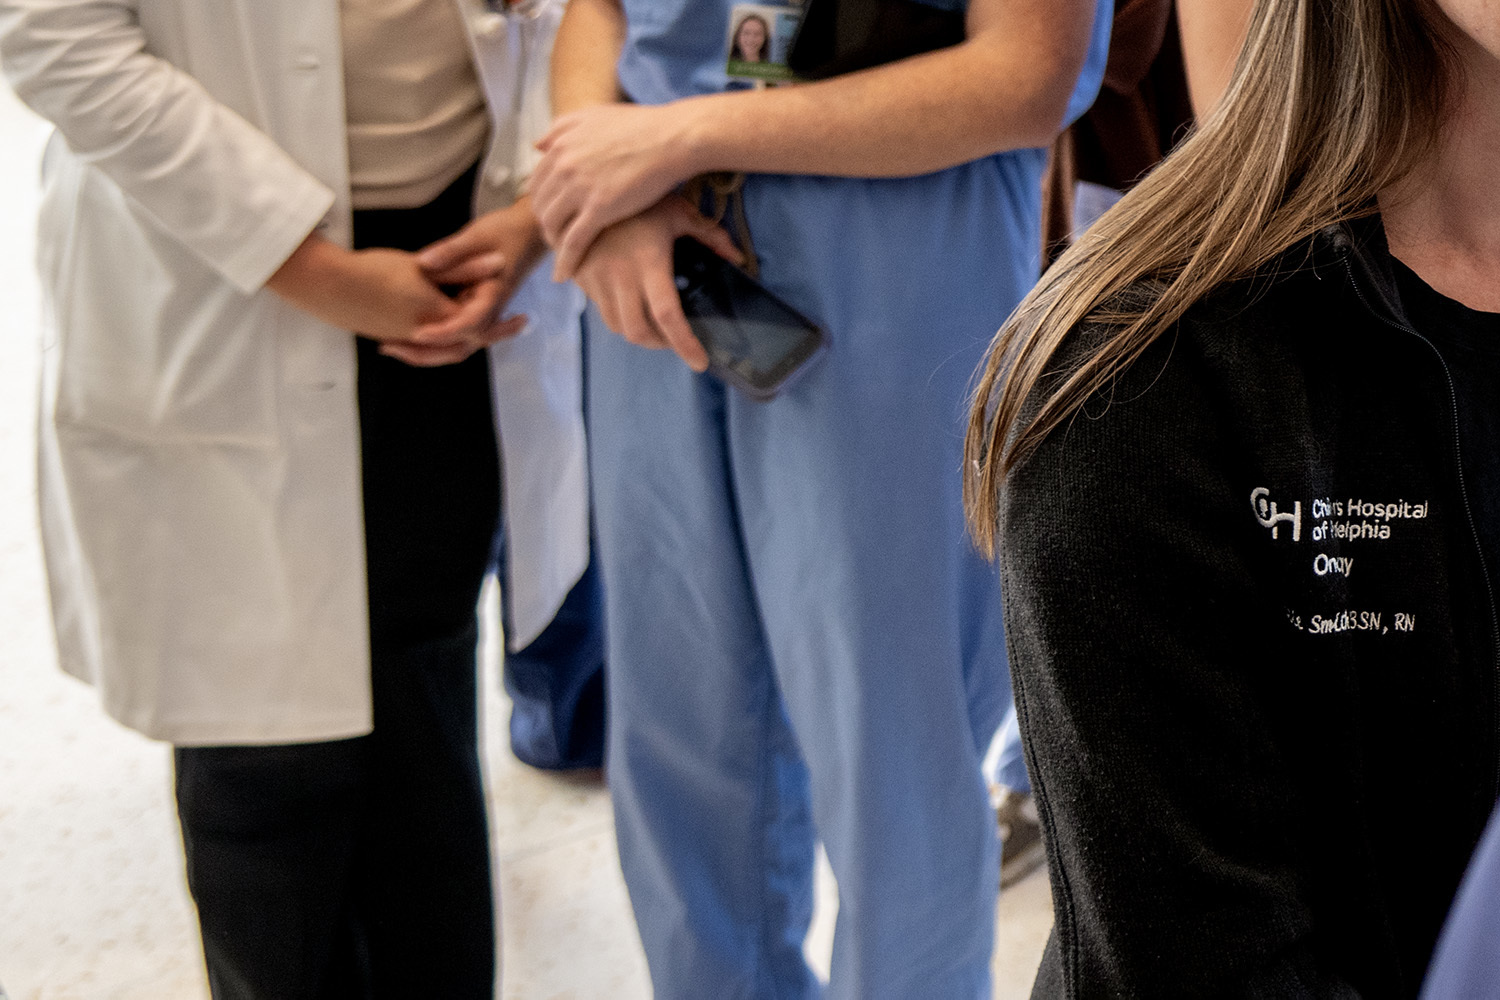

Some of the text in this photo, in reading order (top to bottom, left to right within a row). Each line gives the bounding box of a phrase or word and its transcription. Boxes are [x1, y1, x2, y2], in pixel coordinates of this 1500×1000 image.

[1347, 498, 1429, 522] Hospital
[1312, 520, 1329, 541] of
[1394, 612, 1416, 632] RN
